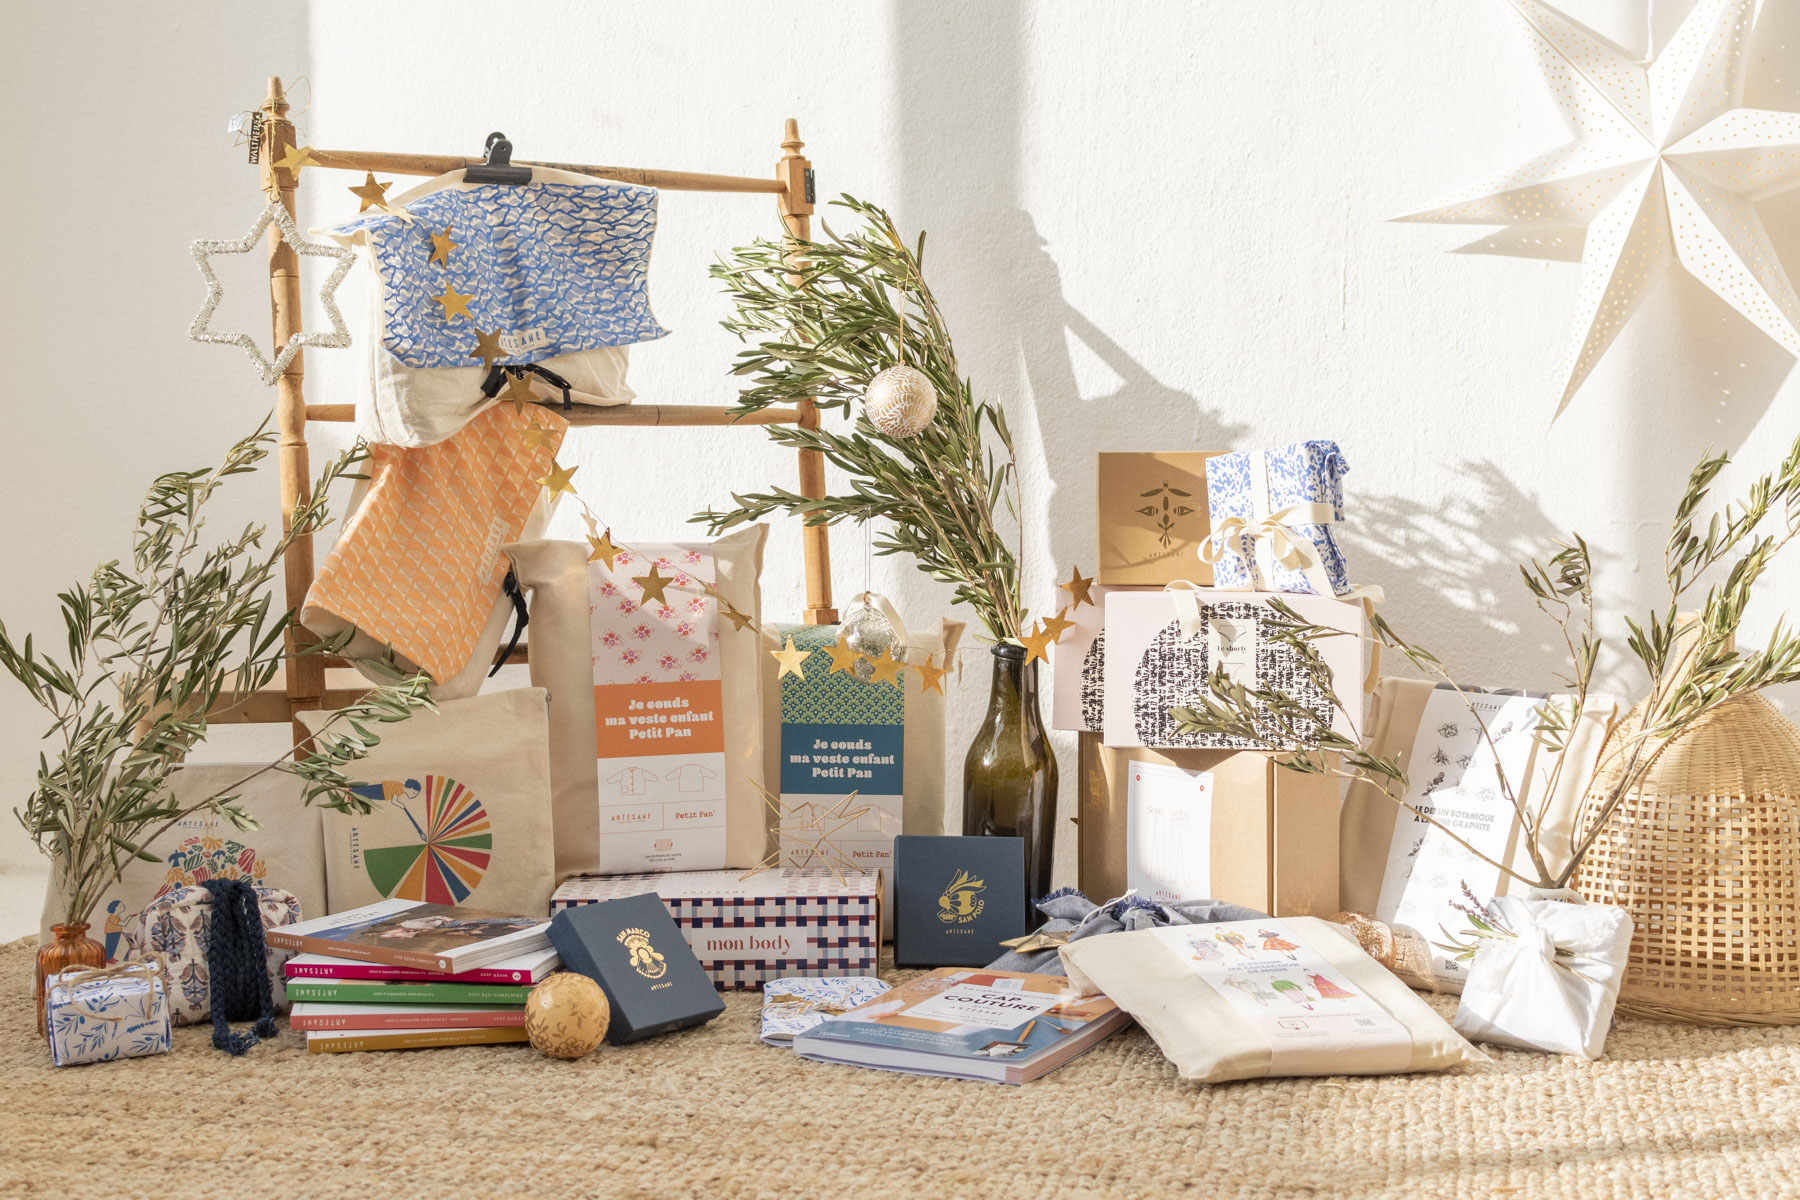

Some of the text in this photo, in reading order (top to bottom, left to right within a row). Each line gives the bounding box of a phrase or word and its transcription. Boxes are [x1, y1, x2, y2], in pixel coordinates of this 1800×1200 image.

[629, 697, 690, 710] Je couds
[605, 711, 714, 726] ma veste enfant
[629, 727, 692, 740] Petit Pan
[813, 739, 872, 750] Je couds
[790, 753, 895, 765] ma veste enfant
[812, 767, 873, 778] Petit Pan
[611, 813, 651, 822] ARTESANE
[675, 811, 698, 820] Petit
[1450, 809, 1495, 823] BOTANIQUE
[1452, 818, 1491, 832] GRAPHITE
[352, 827, 360, 869] ARTESANE
[852, 850, 874, 858] Petit
[959, 899, 985, 924] SAN POLO
[616, 927, 650, 943] SAN MARCO
[273, 937, 303, 946] ARTESANE
[707, 935, 790, 955] mon body
[294, 967, 333, 975] ARTESANE
[296, 989, 337, 997] ARTESANE
[981, 994, 1022, 1002] CAP
[944, 995, 1040, 1012] COUTURE
[303, 1018, 346, 1027] ARTESANE
[320, 1041, 364, 1050] ARTESANE
